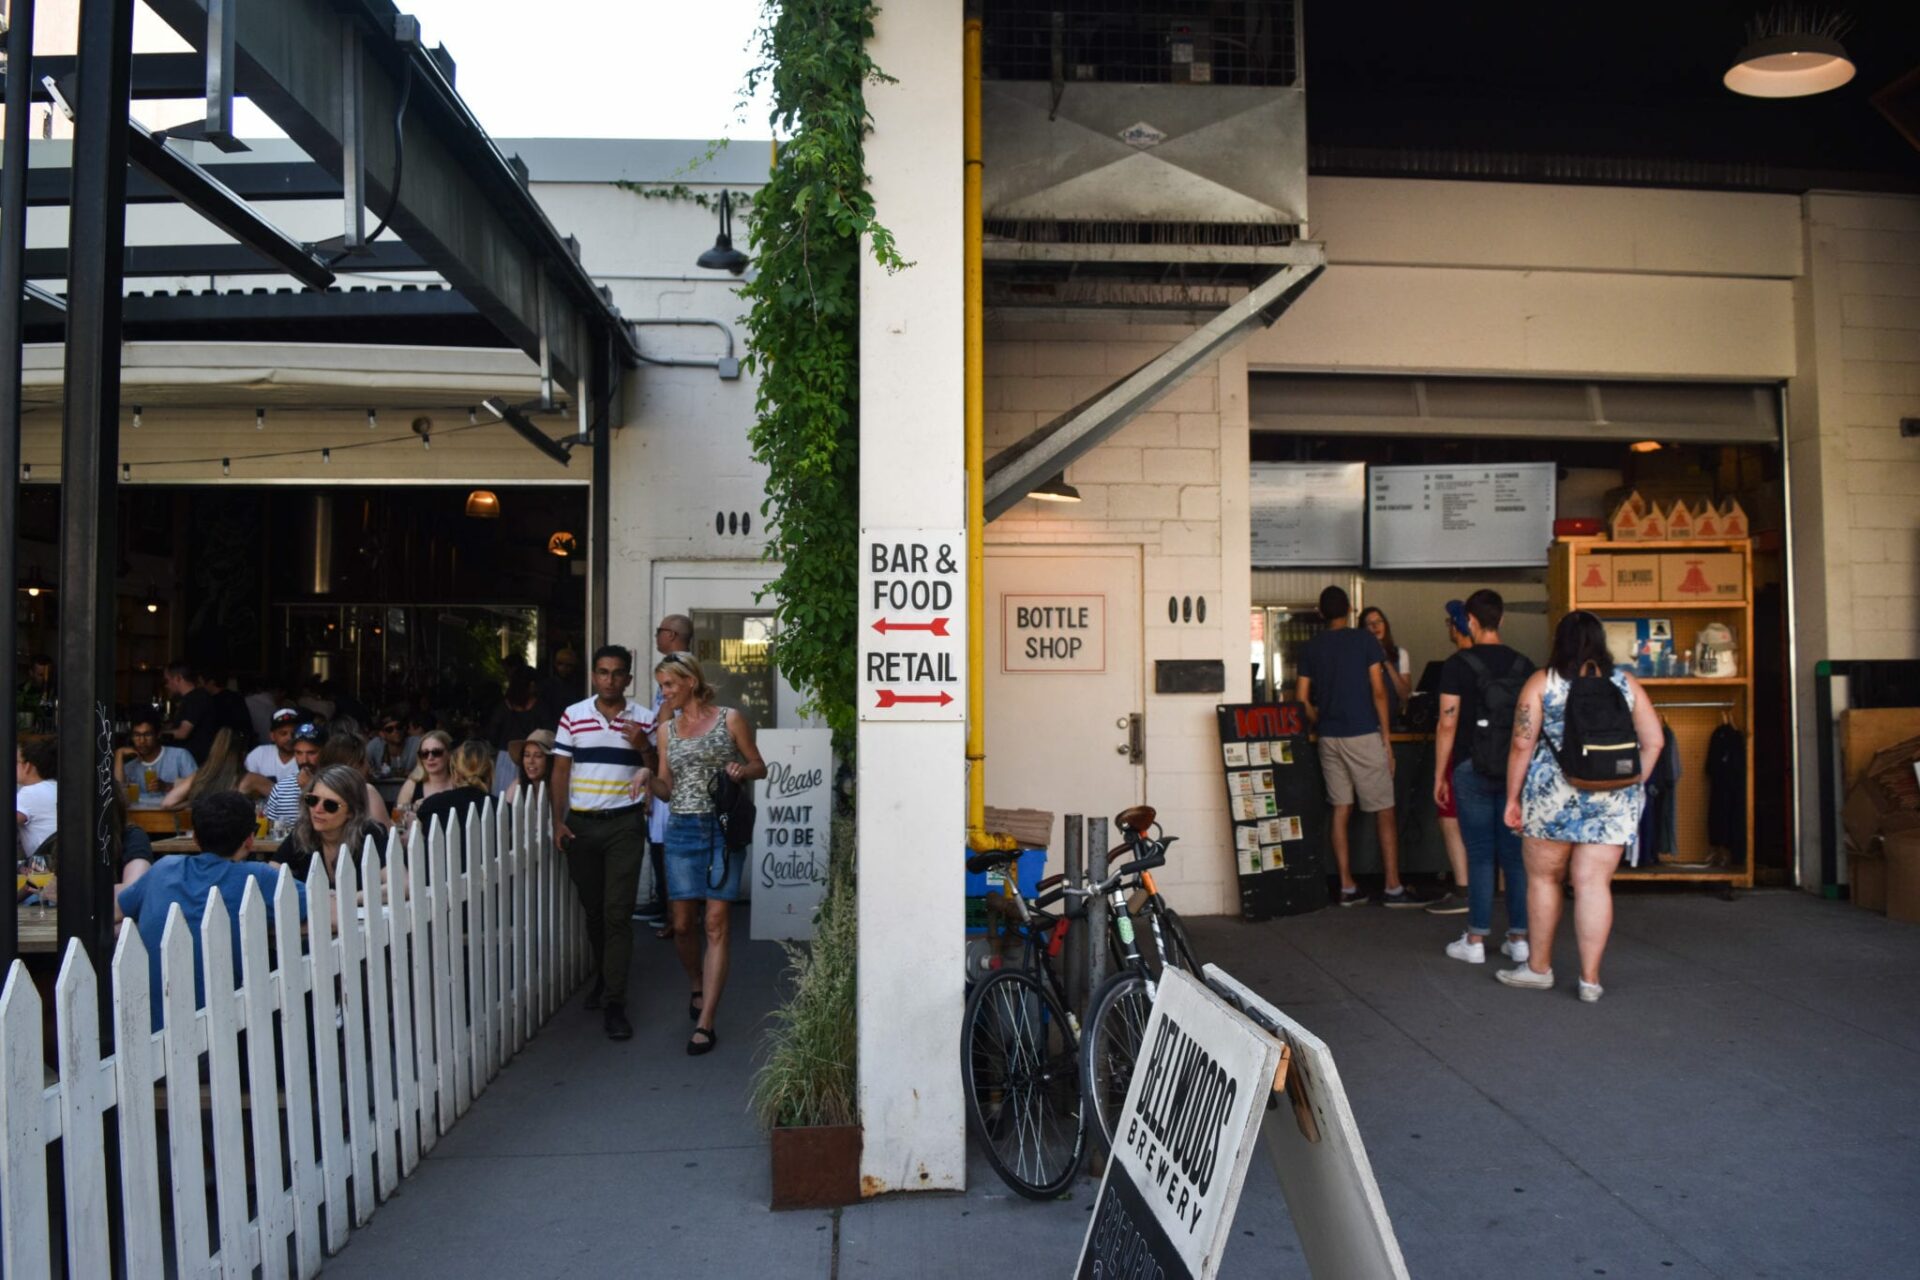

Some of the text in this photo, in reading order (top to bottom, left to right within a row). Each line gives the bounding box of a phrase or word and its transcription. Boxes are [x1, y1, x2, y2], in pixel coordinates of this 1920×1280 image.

[872, 543, 958, 574] BAR &
[874, 580, 952, 610] FOOD
[1017, 607, 1088, 628] BOTTLE
[1025, 637, 1082, 659] SHOP
[867, 652, 957, 682] RETAIL
[1235, 706, 1303, 738] BOTTLES
[765, 761, 823, 799] Please
[768, 806, 813, 824] WAIT
[765, 828, 814, 846] TO BE
[762, 851, 815, 889] Seated
[1136, 1012, 1237, 1197] BELLWOODS
[1127, 1118, 1203, 1234] BREWERY
